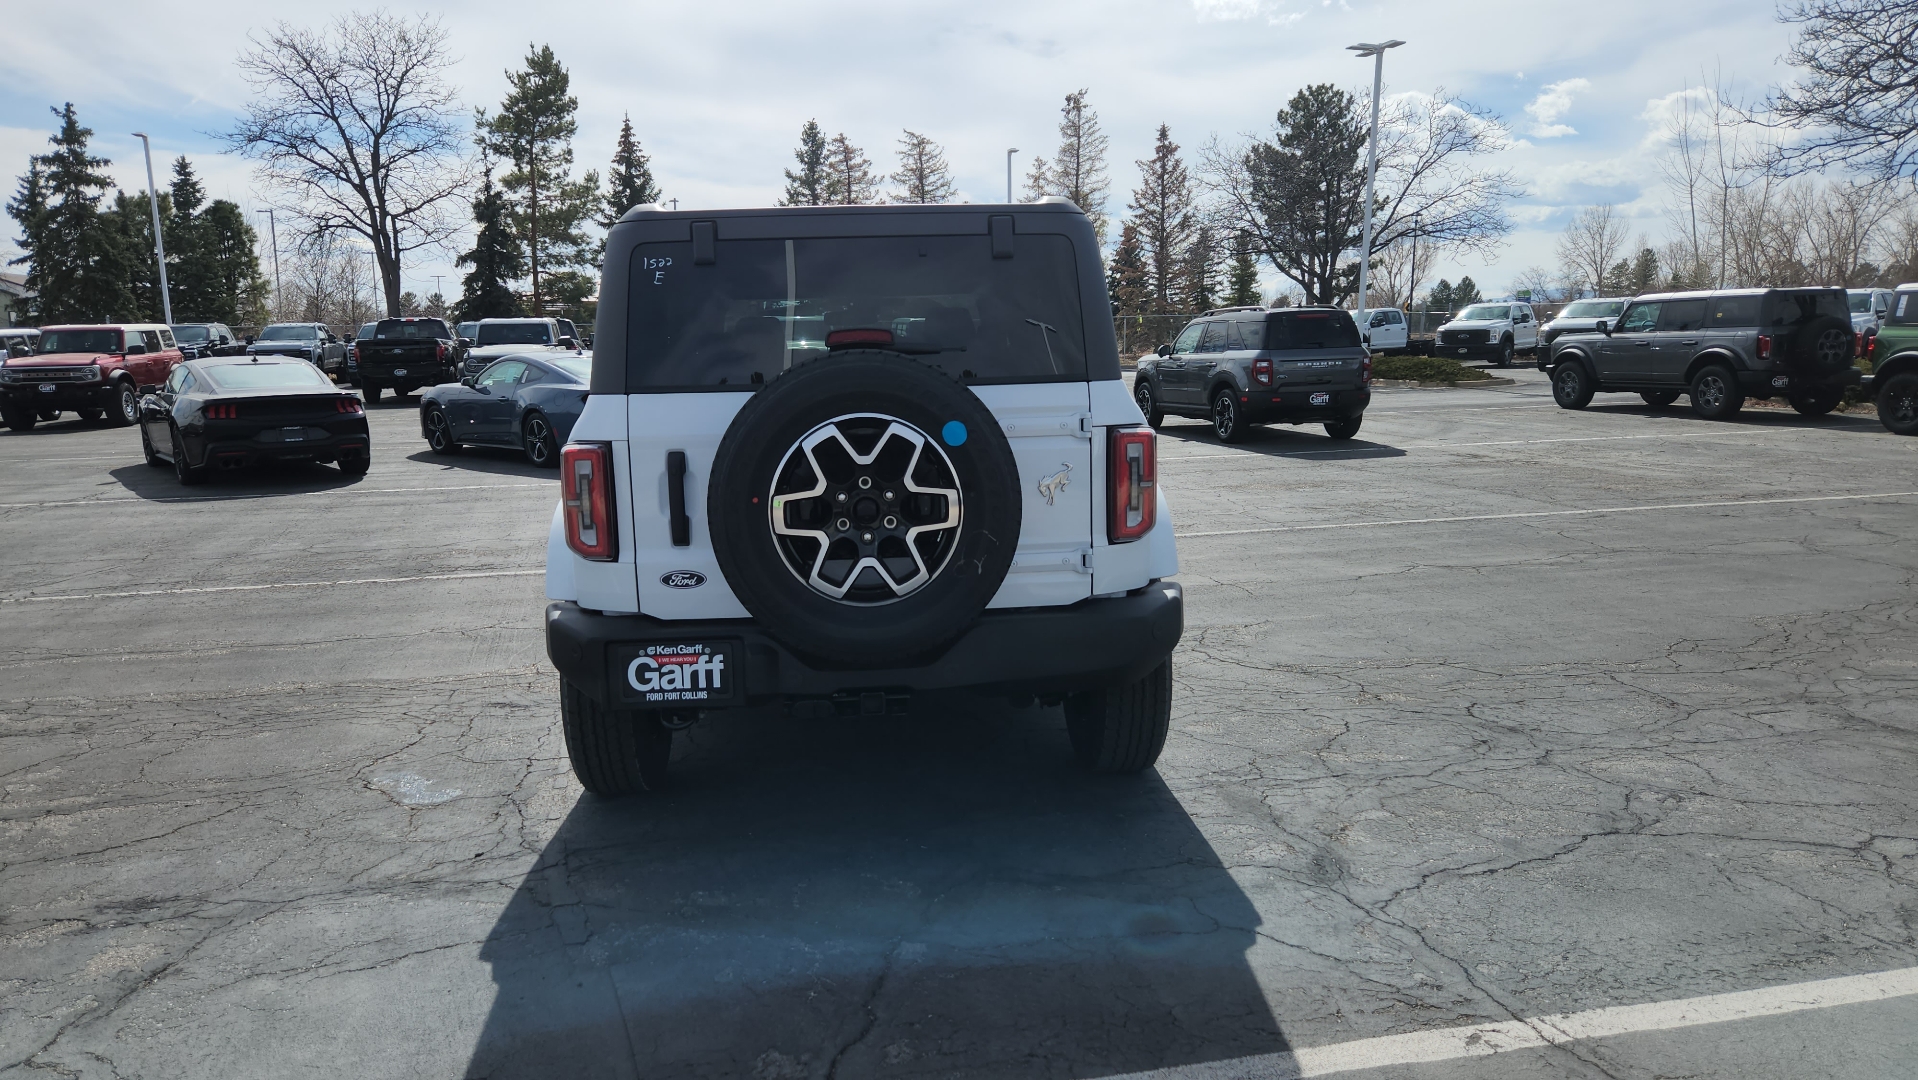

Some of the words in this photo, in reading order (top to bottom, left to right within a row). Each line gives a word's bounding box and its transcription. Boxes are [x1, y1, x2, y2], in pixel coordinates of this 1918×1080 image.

[653, 271, 665, 284] E
[1309, 394, 1329, 403] Garff
[669, 574, 697, 585] Ford
[656, 645, 677, 655] Ken
[677, 644, 703, 655] Garff
[627, 654, 724, 691] Garff
[646, 692, 664, 701] FORD
[664, 692, 681, 701] FORT
[681, 690, 708, 700] COLLINS
